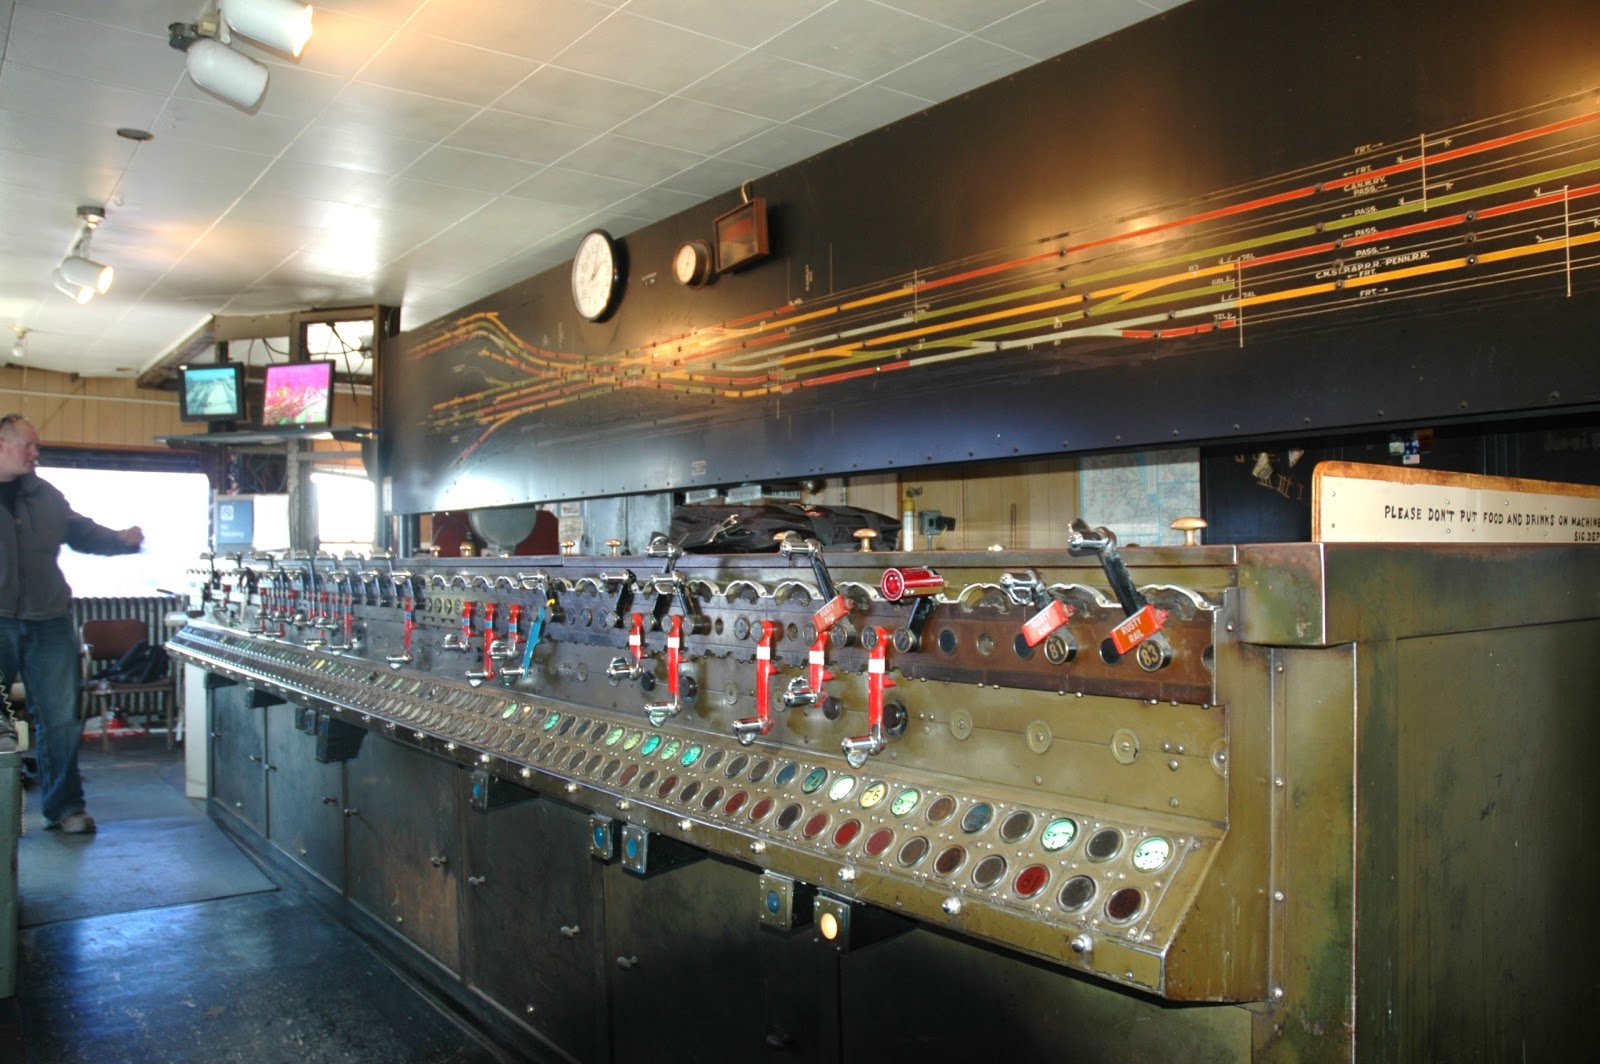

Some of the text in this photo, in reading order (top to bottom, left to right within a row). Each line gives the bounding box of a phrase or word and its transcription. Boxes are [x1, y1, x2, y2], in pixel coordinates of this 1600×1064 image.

[1384, 505, 1422, 520] PLEASE
[1428, 507, 1454, 523] DON'T
[1460, 510, 1477, 523] PUT
[1483, 512, 1503, 525] FOOD
[1507, 513, 1523, 526] AND
[1525, 513, 1555, 526] DRINKS
[1558, 515, 1568, 526] ON
[1121, 615, 1142, 635] RUSTY
[1129, 630, 1144, 644] RAIL
[1048, 637, 1063, 660] 81
[1140, 644, 1159, 667] 83
